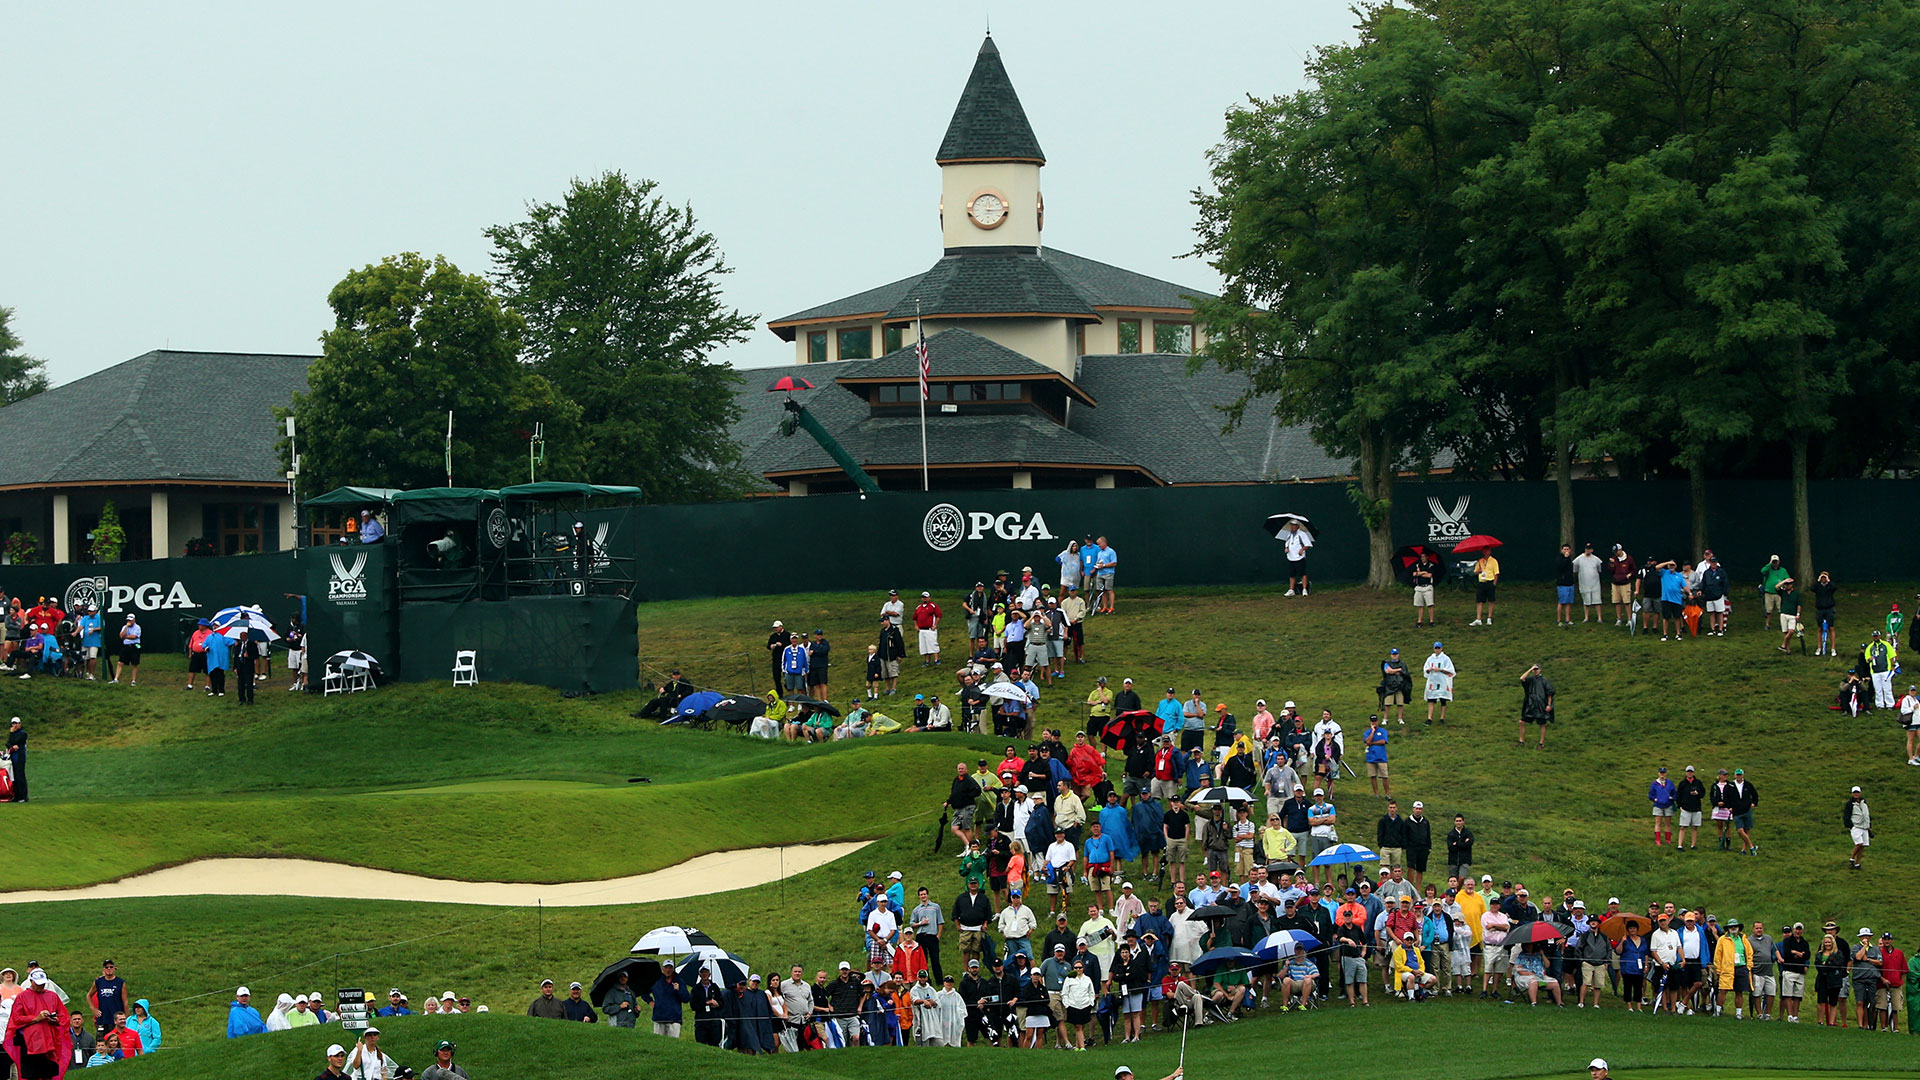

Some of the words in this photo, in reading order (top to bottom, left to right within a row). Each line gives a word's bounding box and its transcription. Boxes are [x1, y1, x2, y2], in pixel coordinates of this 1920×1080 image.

[933, 523, 956, 532] PGA
[968, 512, 1053, 540] PGA
[1428, 522, 1471, 536] PGA
[328, 580, 367, 594] PGA
[573, 582, 582, 594] 9
[107, 581, 196, 613] PGA
